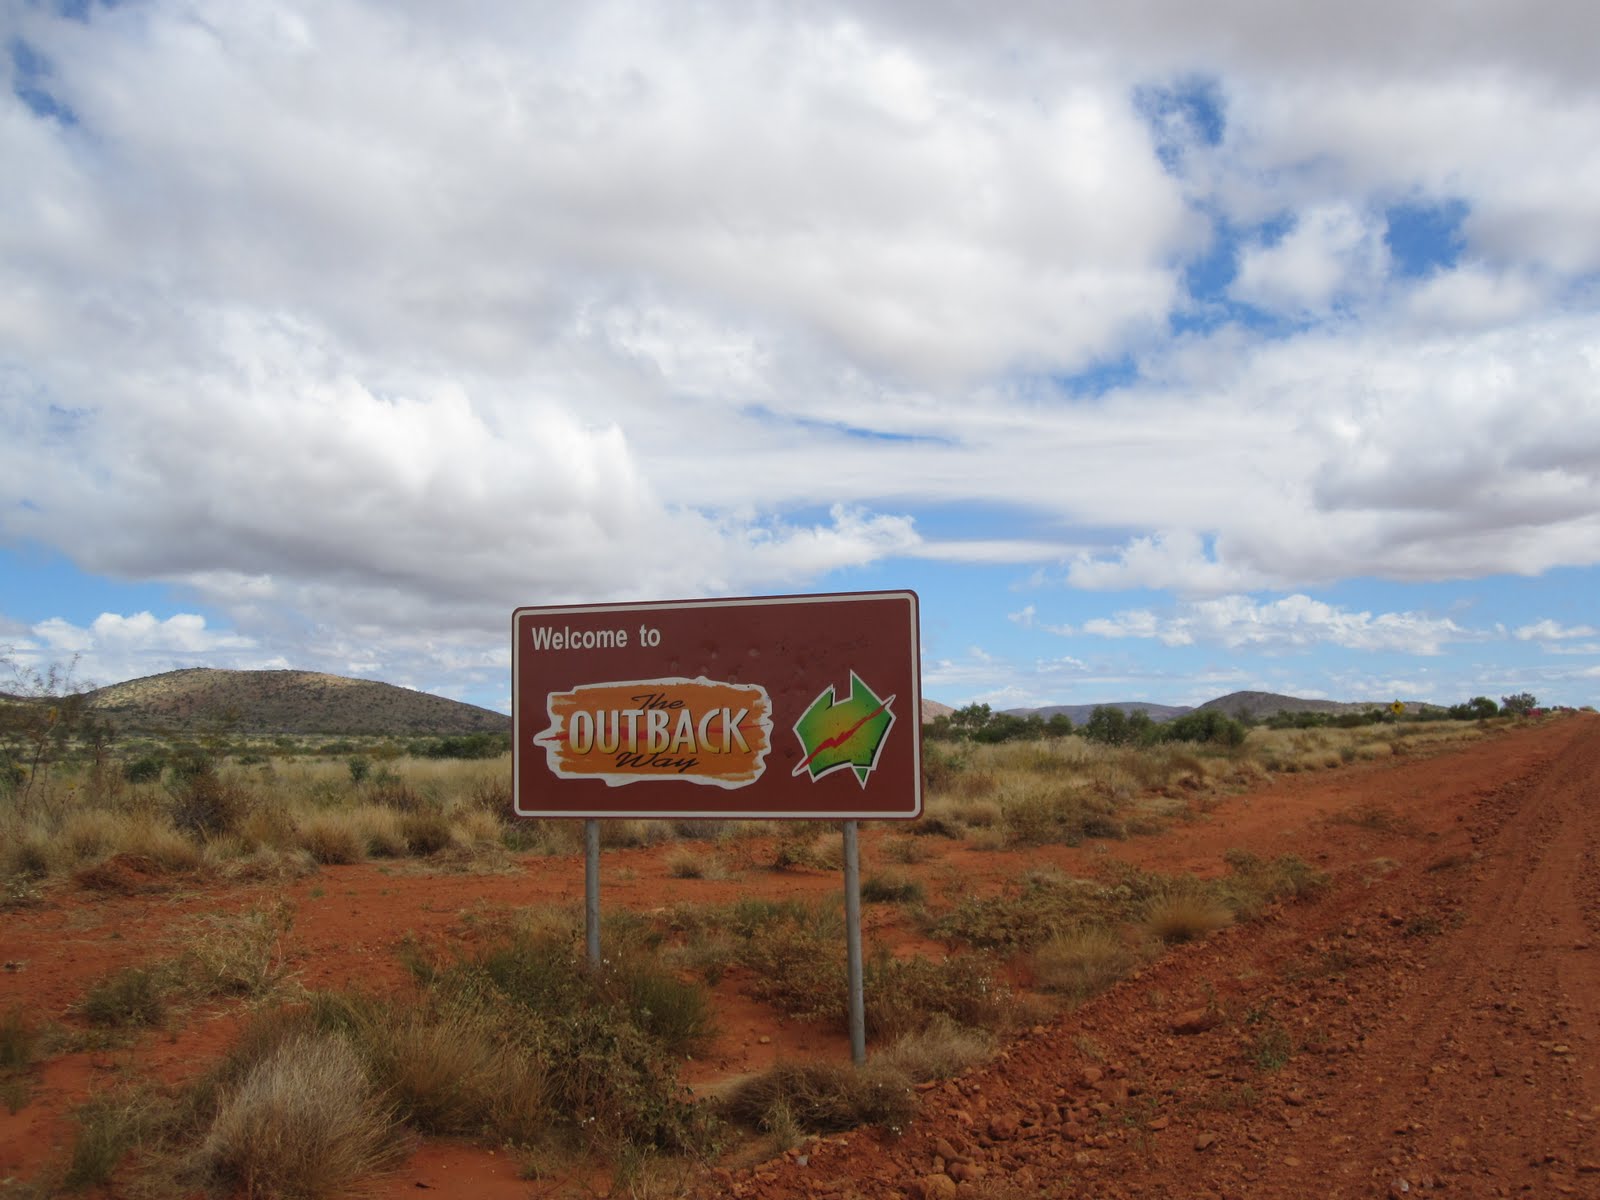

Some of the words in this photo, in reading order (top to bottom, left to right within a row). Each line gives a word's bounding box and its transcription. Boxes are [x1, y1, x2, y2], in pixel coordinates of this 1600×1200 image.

[531, 626, 628, 650] Welcome
[639, 624, 661, 647] to
[631, 692, 685, 711] The
[569, 707, 752, 755] OUTBACK
[615, 751, 700, 773] Way
